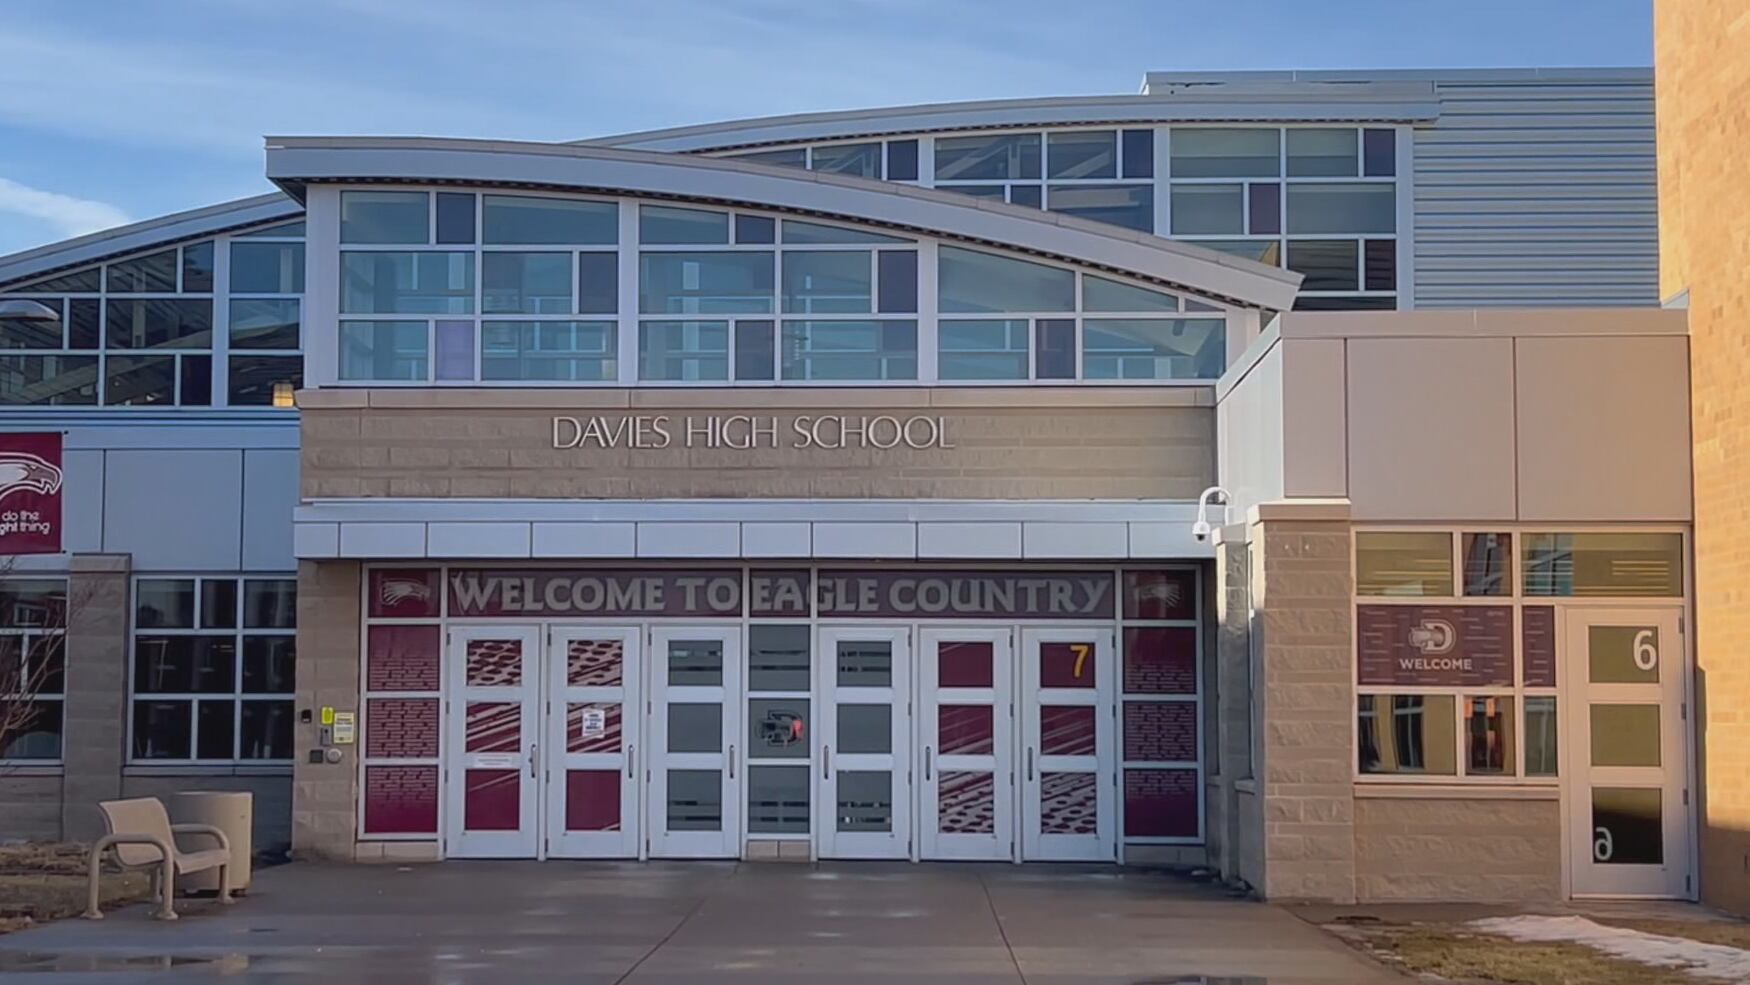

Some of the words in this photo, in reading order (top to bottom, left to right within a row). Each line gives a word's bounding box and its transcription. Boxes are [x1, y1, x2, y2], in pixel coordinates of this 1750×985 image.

[552, 415, 671, 449] DAVIES
[686, 415, 778, 449] HIGH
[793, 415, 956, 449] SCHOOL
[1, 510, 18, 521] do
[20, 510, 40, 521] the
[20, 522, 50, 535] thing
[452, 575, 665, 614] WELCOME
[675, 577, 741, 612] TO
[752, 579, 877, 612] EAGLE
[889, 579, 1109, 613] COUNTRY
[1070, 645, 1089, 677] 7
[1399, 658, 1472, 670] WELCOME
[1632, 630, 1657, 671] 6
